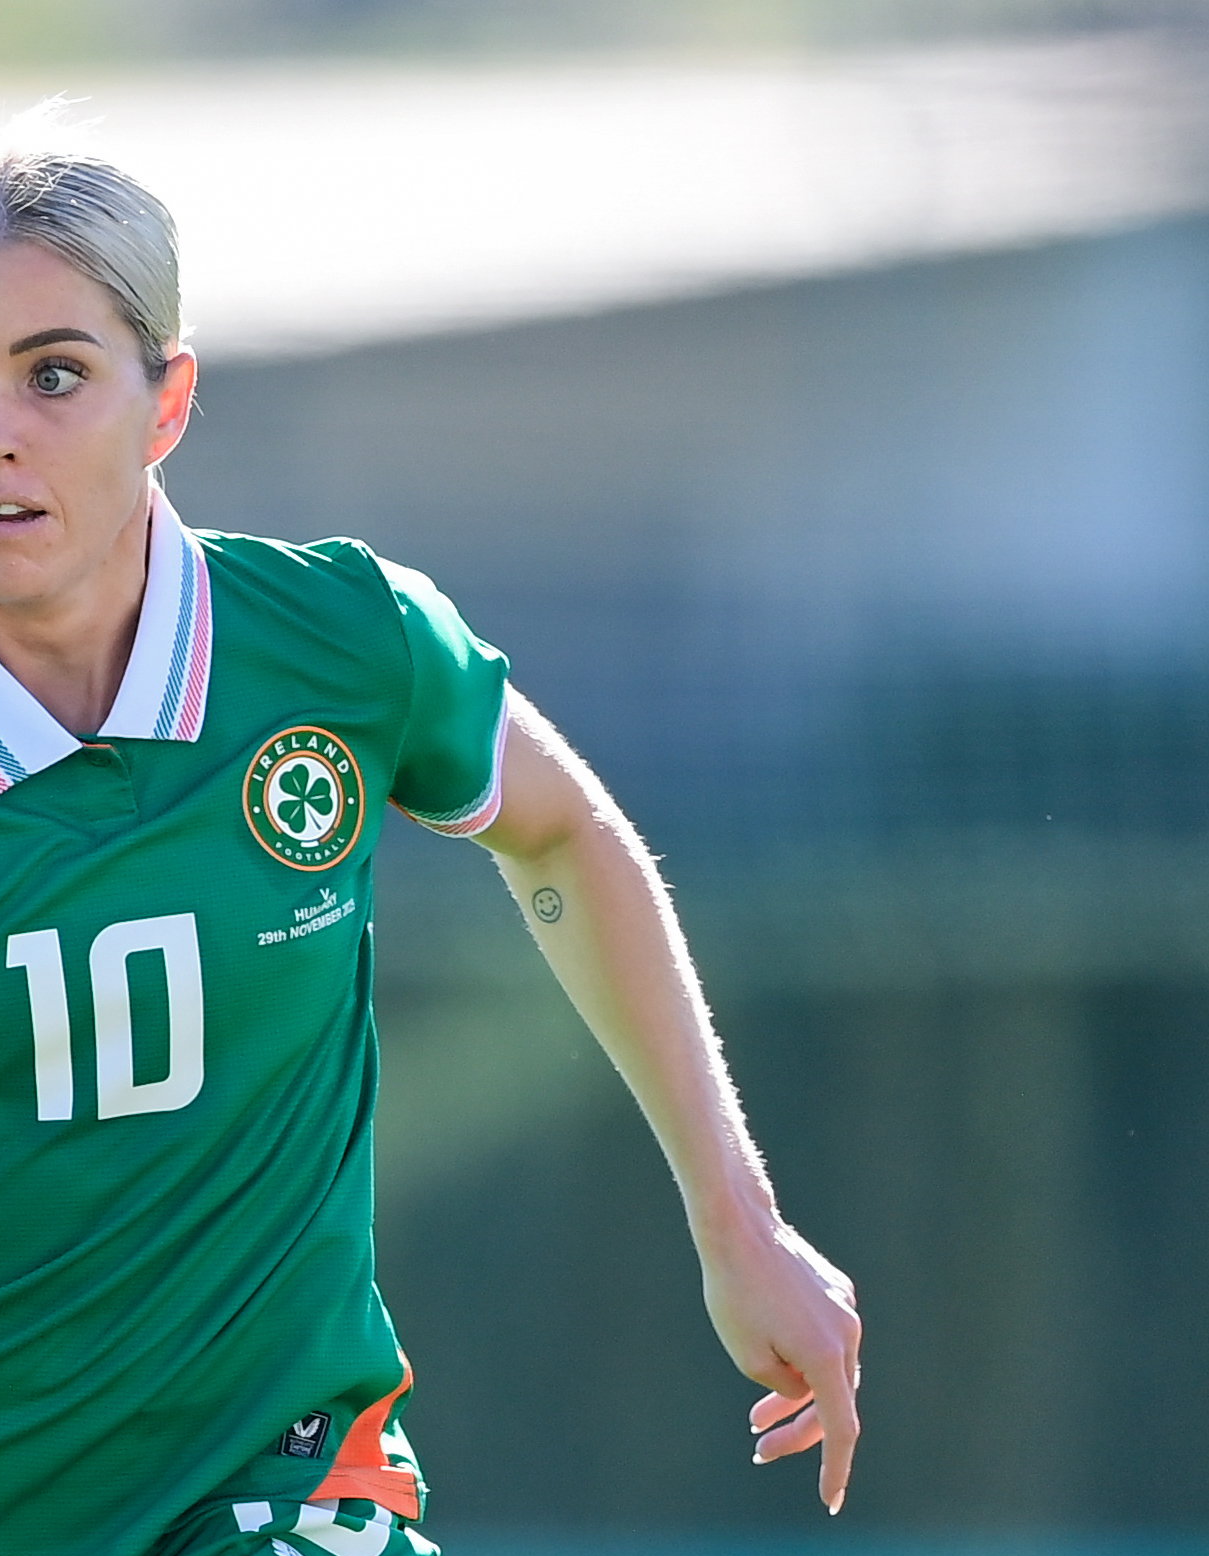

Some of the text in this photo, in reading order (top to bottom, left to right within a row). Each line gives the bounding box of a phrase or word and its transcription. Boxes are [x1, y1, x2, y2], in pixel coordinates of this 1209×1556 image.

[252, 735, 351, 782] IRELAND
[275, 836, 346, 862] FOOTBALL
[257, 929, 287, 946] 29th
[289, 907, 342, 940] NOVEMBER
[5, 911, 205, 1122] 10
